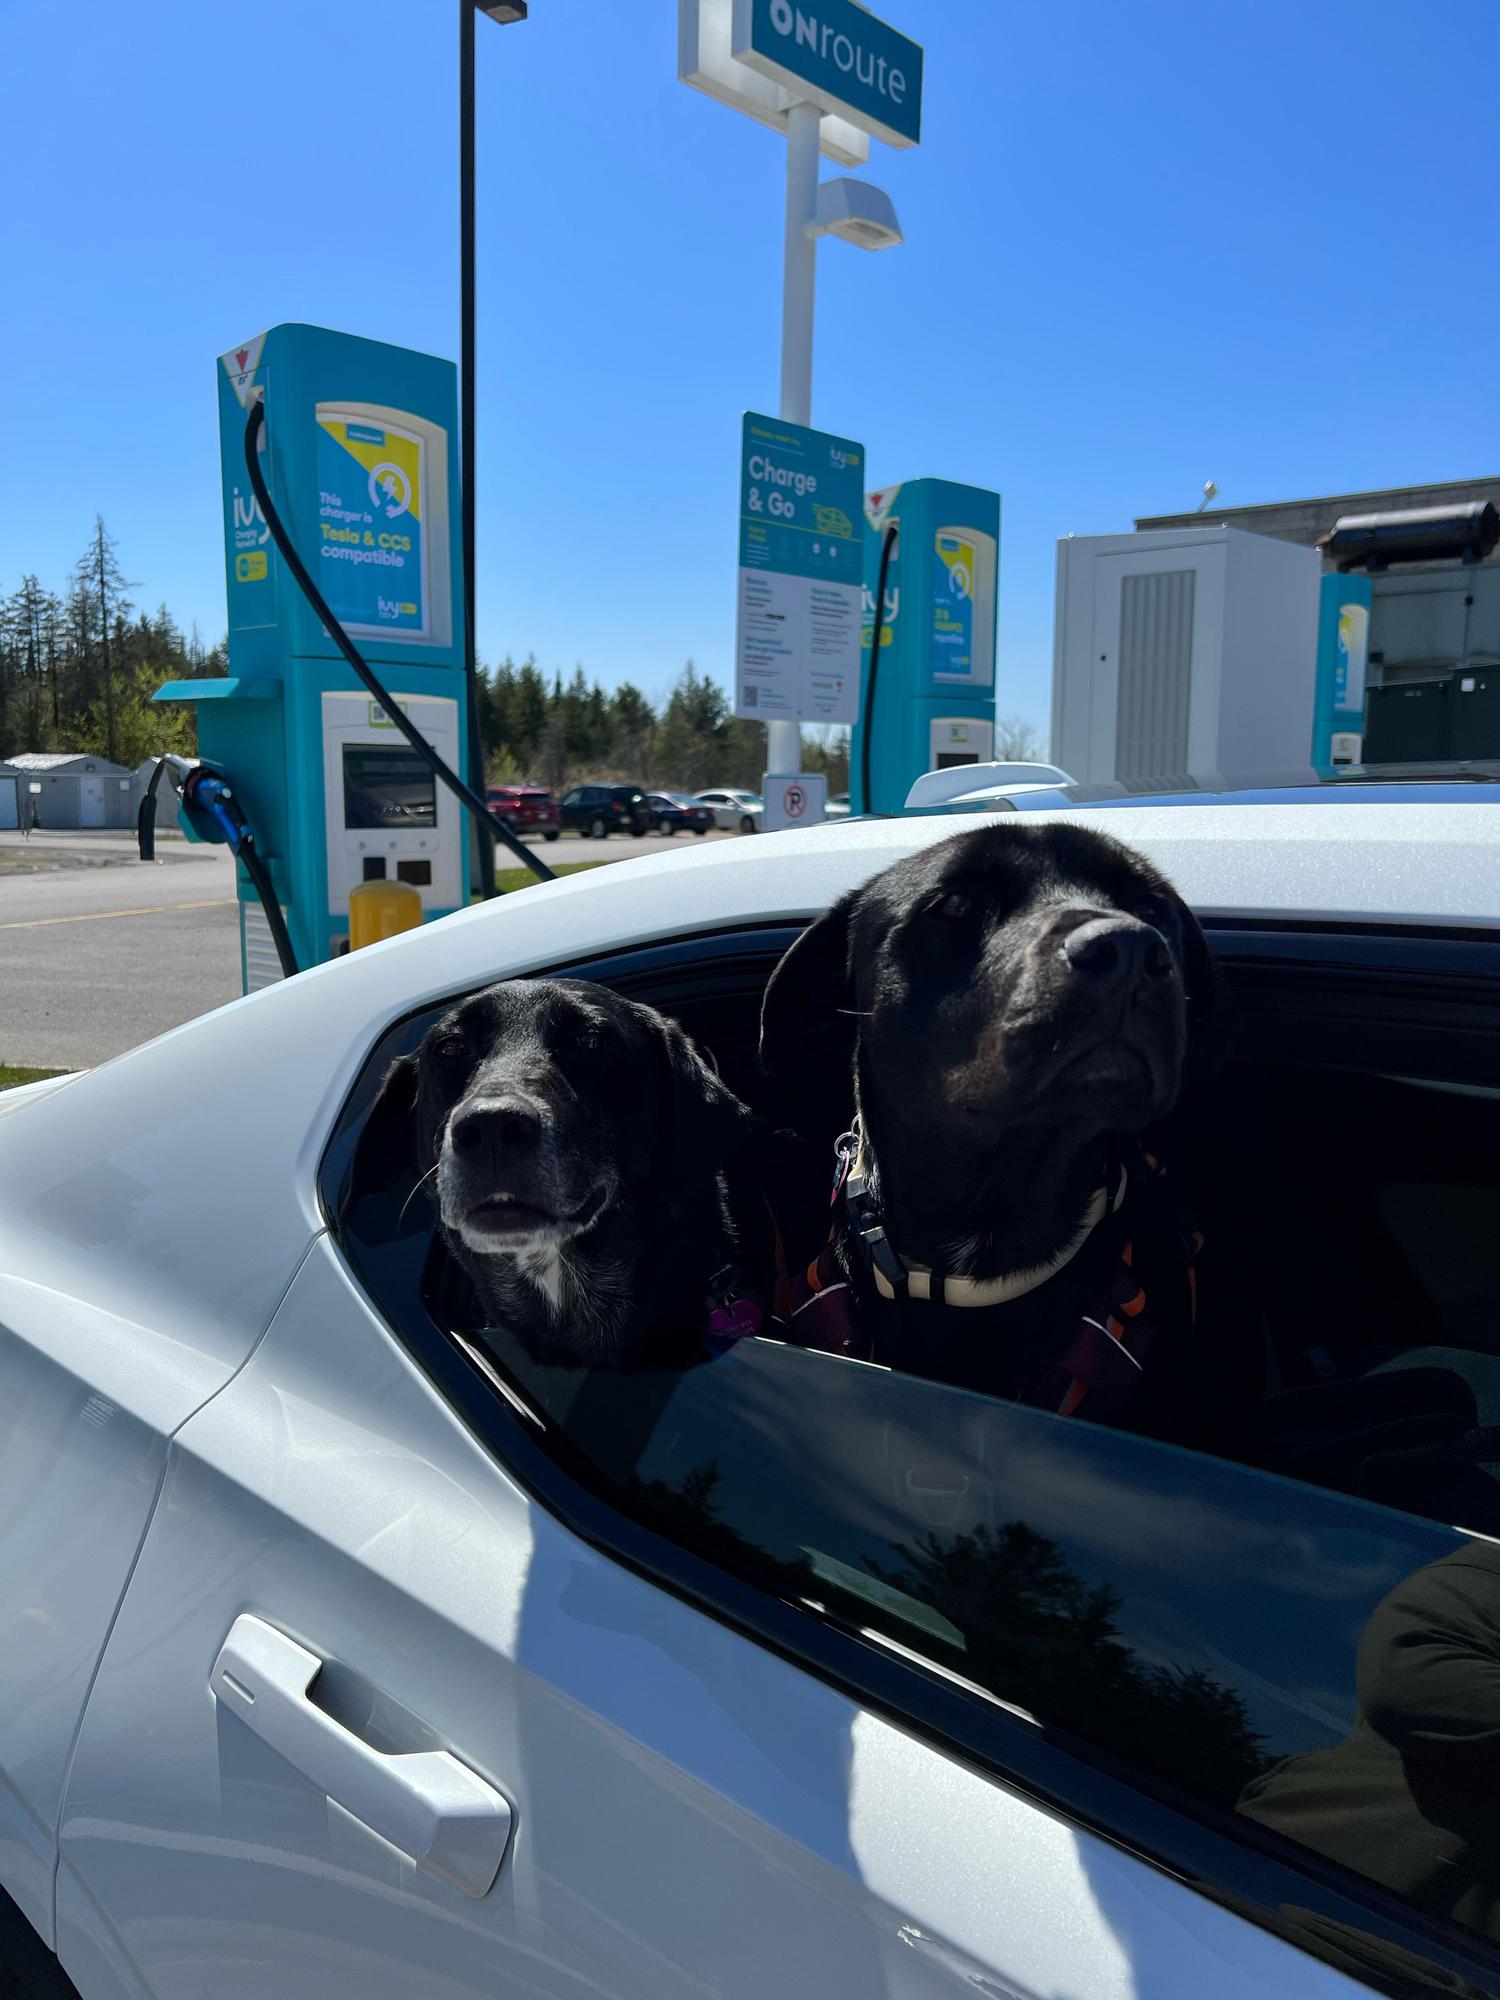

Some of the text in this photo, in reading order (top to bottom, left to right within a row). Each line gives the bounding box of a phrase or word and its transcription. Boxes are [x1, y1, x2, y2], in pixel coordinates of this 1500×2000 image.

[769, 0, 907, 104] ONroute
[748, 455, 817, 496] Charge
[320, 491, 342, 507] This
[748, 487, 796, 519] & Go
[319, 505, 373, 524] charger is
[320, 523, 411, 552] Tesla & CCS
[321, 545, 405, 568] compatible
[377, 596, 400, 620] ivy
